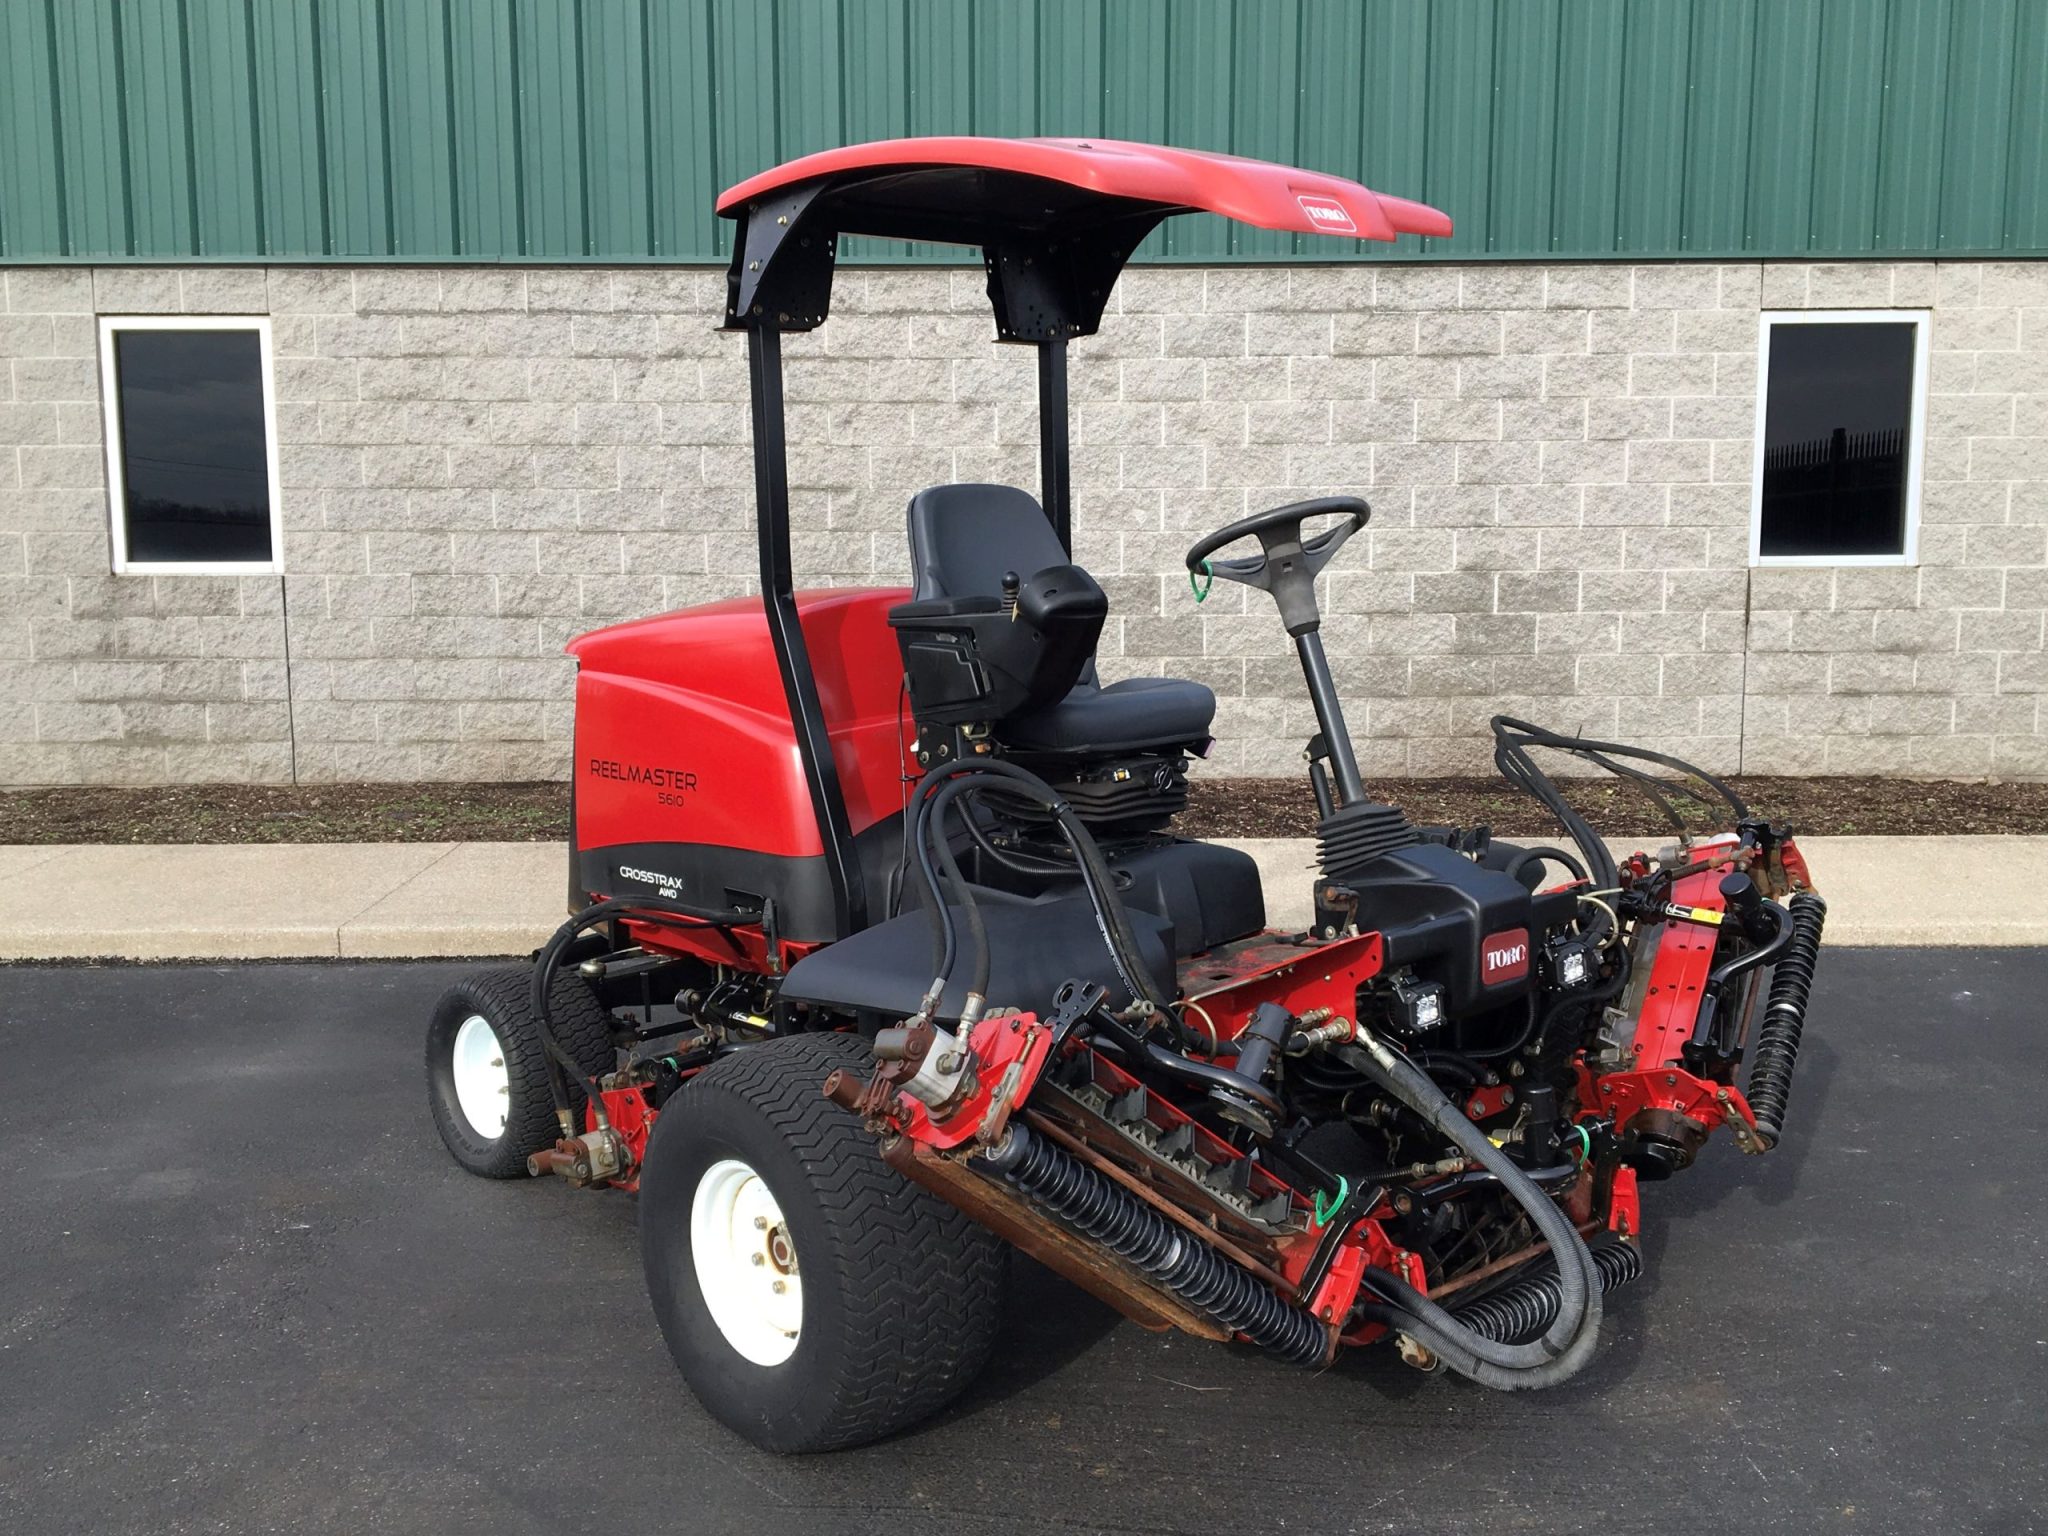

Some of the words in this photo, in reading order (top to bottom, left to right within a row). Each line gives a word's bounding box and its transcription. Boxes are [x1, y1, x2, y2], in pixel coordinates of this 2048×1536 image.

[1304, 206, 1349, 221] TORO
[590, 759, 697, 791] REELMASTER
[658, 792, 684, 807] 5610
[619, 865, 683, 890] CROSSTRAX
[658, 887, 678, 899] AWD
[1487, 944, 1527, 971] TORO
